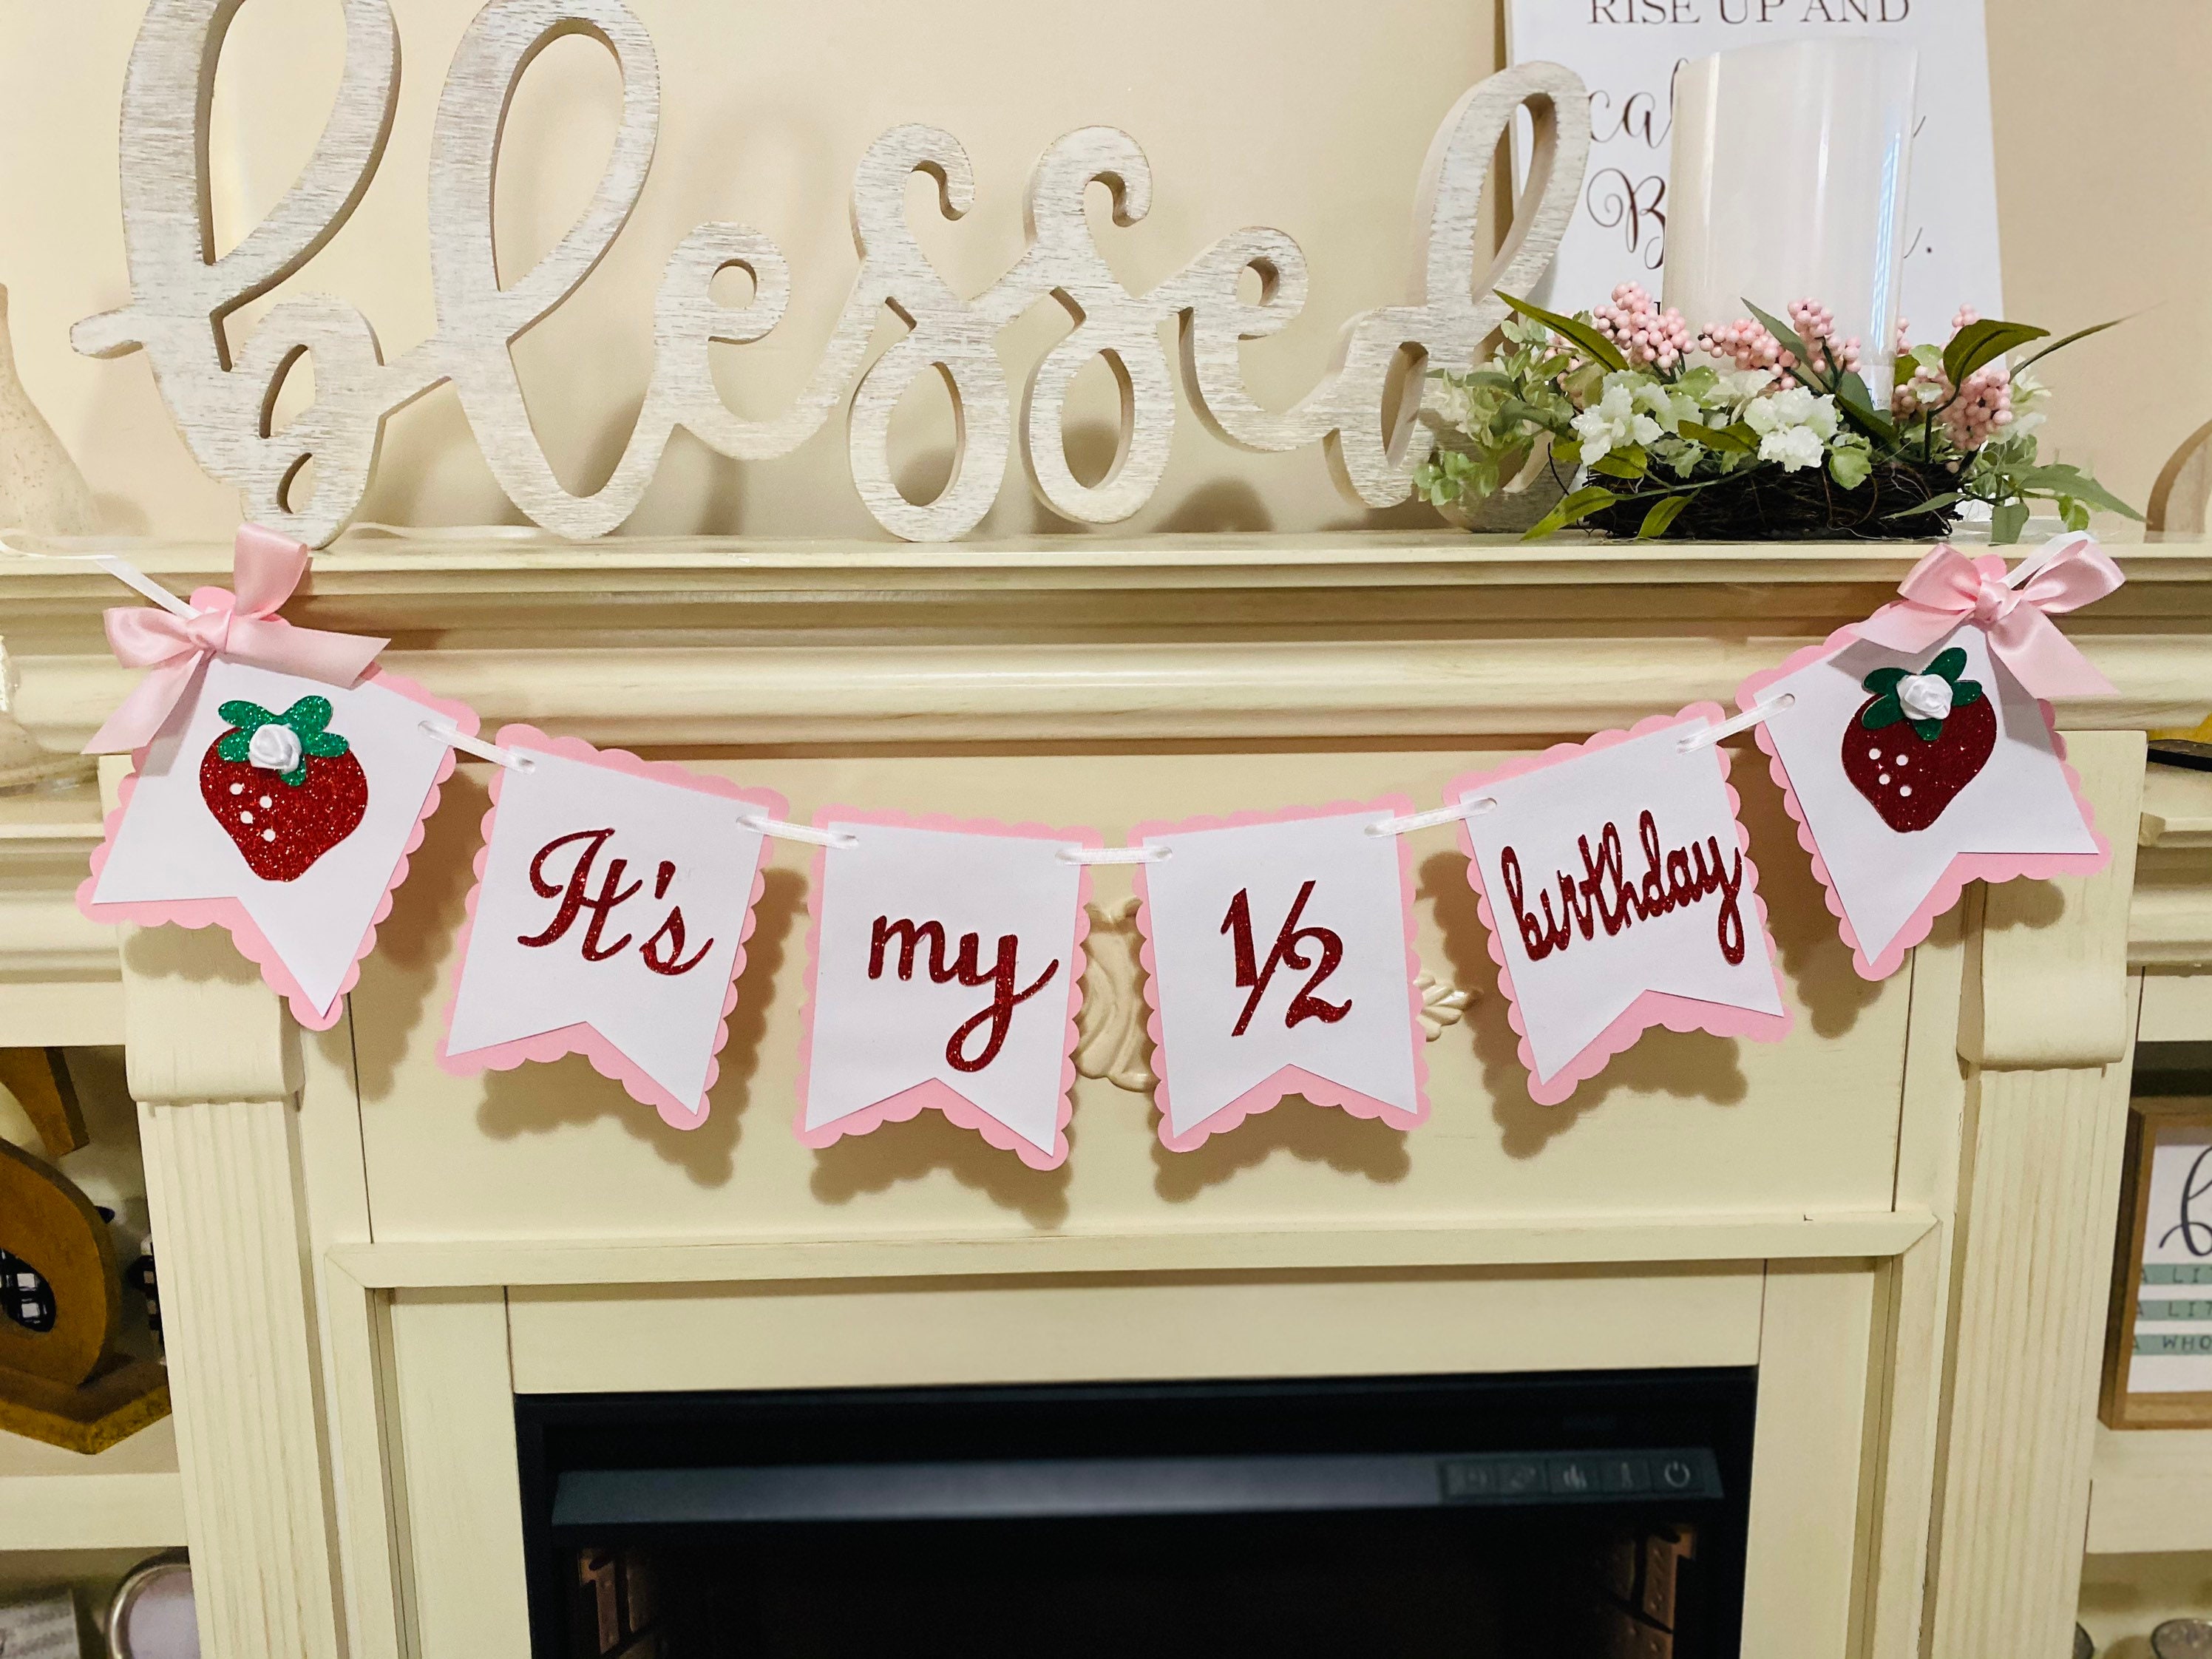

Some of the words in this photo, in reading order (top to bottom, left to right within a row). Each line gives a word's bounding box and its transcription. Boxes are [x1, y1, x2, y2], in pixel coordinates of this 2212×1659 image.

[1587, 0, 1701, 24] RISE
[1718, 0, 1784, 24] UP
[1799, 0, 1910, 23] AND
[69, 0, 1590, 548] blessed
[517, 827, 714, 976] It's
[868, 915, 1059, 1073] my
[1501, 809, 1743, 966] birthday
